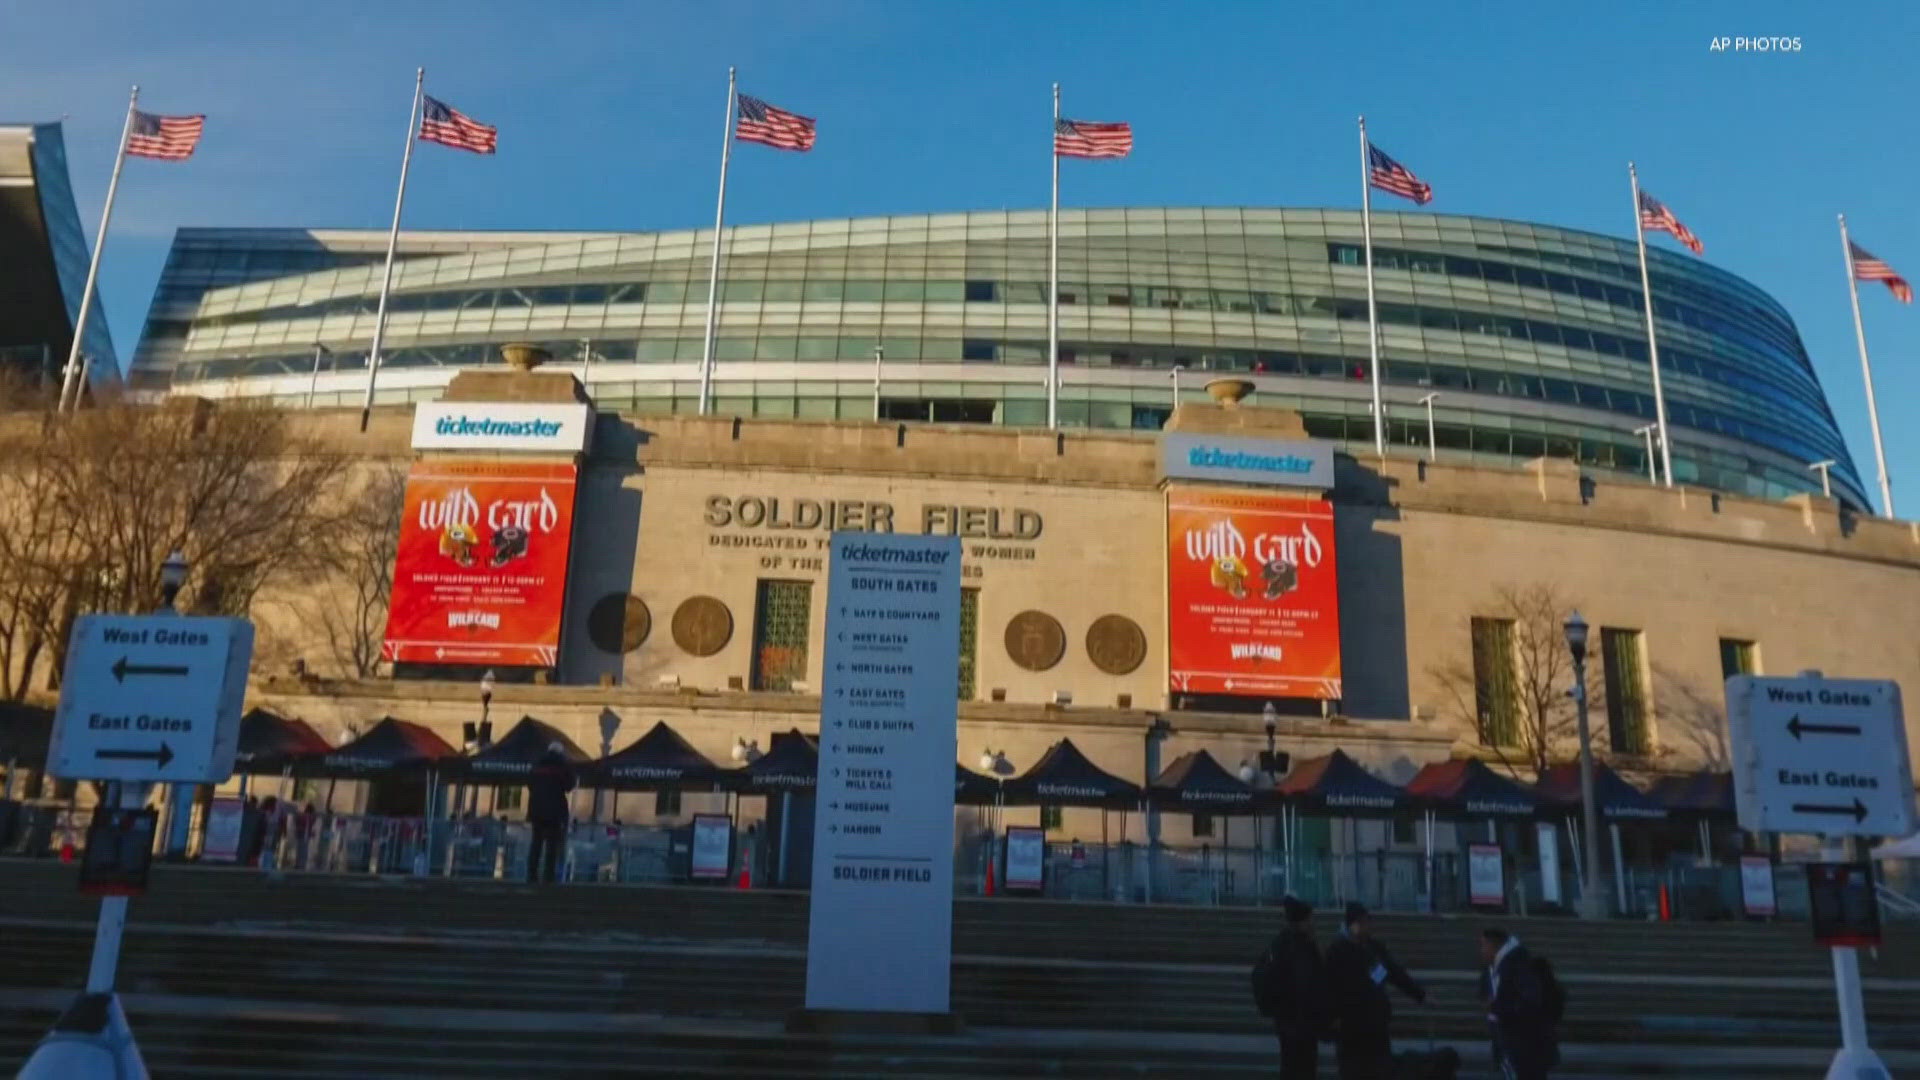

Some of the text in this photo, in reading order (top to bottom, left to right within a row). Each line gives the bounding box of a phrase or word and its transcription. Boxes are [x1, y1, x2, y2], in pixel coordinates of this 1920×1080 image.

[435, 416, 563, 437] ticketmaster
[1188, 447, 1315, 474] ticketmaster
[703, 494, 1044, 540] SOLDIER FIELD
[709, 535, 808, 549] DEDICATED
[841, 543, 950, 564] ticketmaster
[971, 546, 1035, 560] WOMEN
[760, 556, 823, 571] OF THE
[851, 577, 938, 593] SOUTH GATES
[887, 610, 940, 620] COURTYARD
[103, 628, 209, 646] West Gates
[853, 633, 908, 643] WEST GATES
[851, 664, 913, 674] NORTH GATES
[850, 688, 905, 699] EAST GATES
[1767, 687, 1872, 706] West Gates
[88, 713, 193, 732] East Gates
[848, 720, 872, 730] CLUB
[882, 721, 914, 731] SUITES
[847, 745, 885, 755] MIDWAY
[846, 769, 884, 779] TICKETS
[1778, 770, 1879, 789] East Gates
[846, 780, 892, 790] WILL CALL
[833, 866, 932, 882] SOLDIER FIELD
